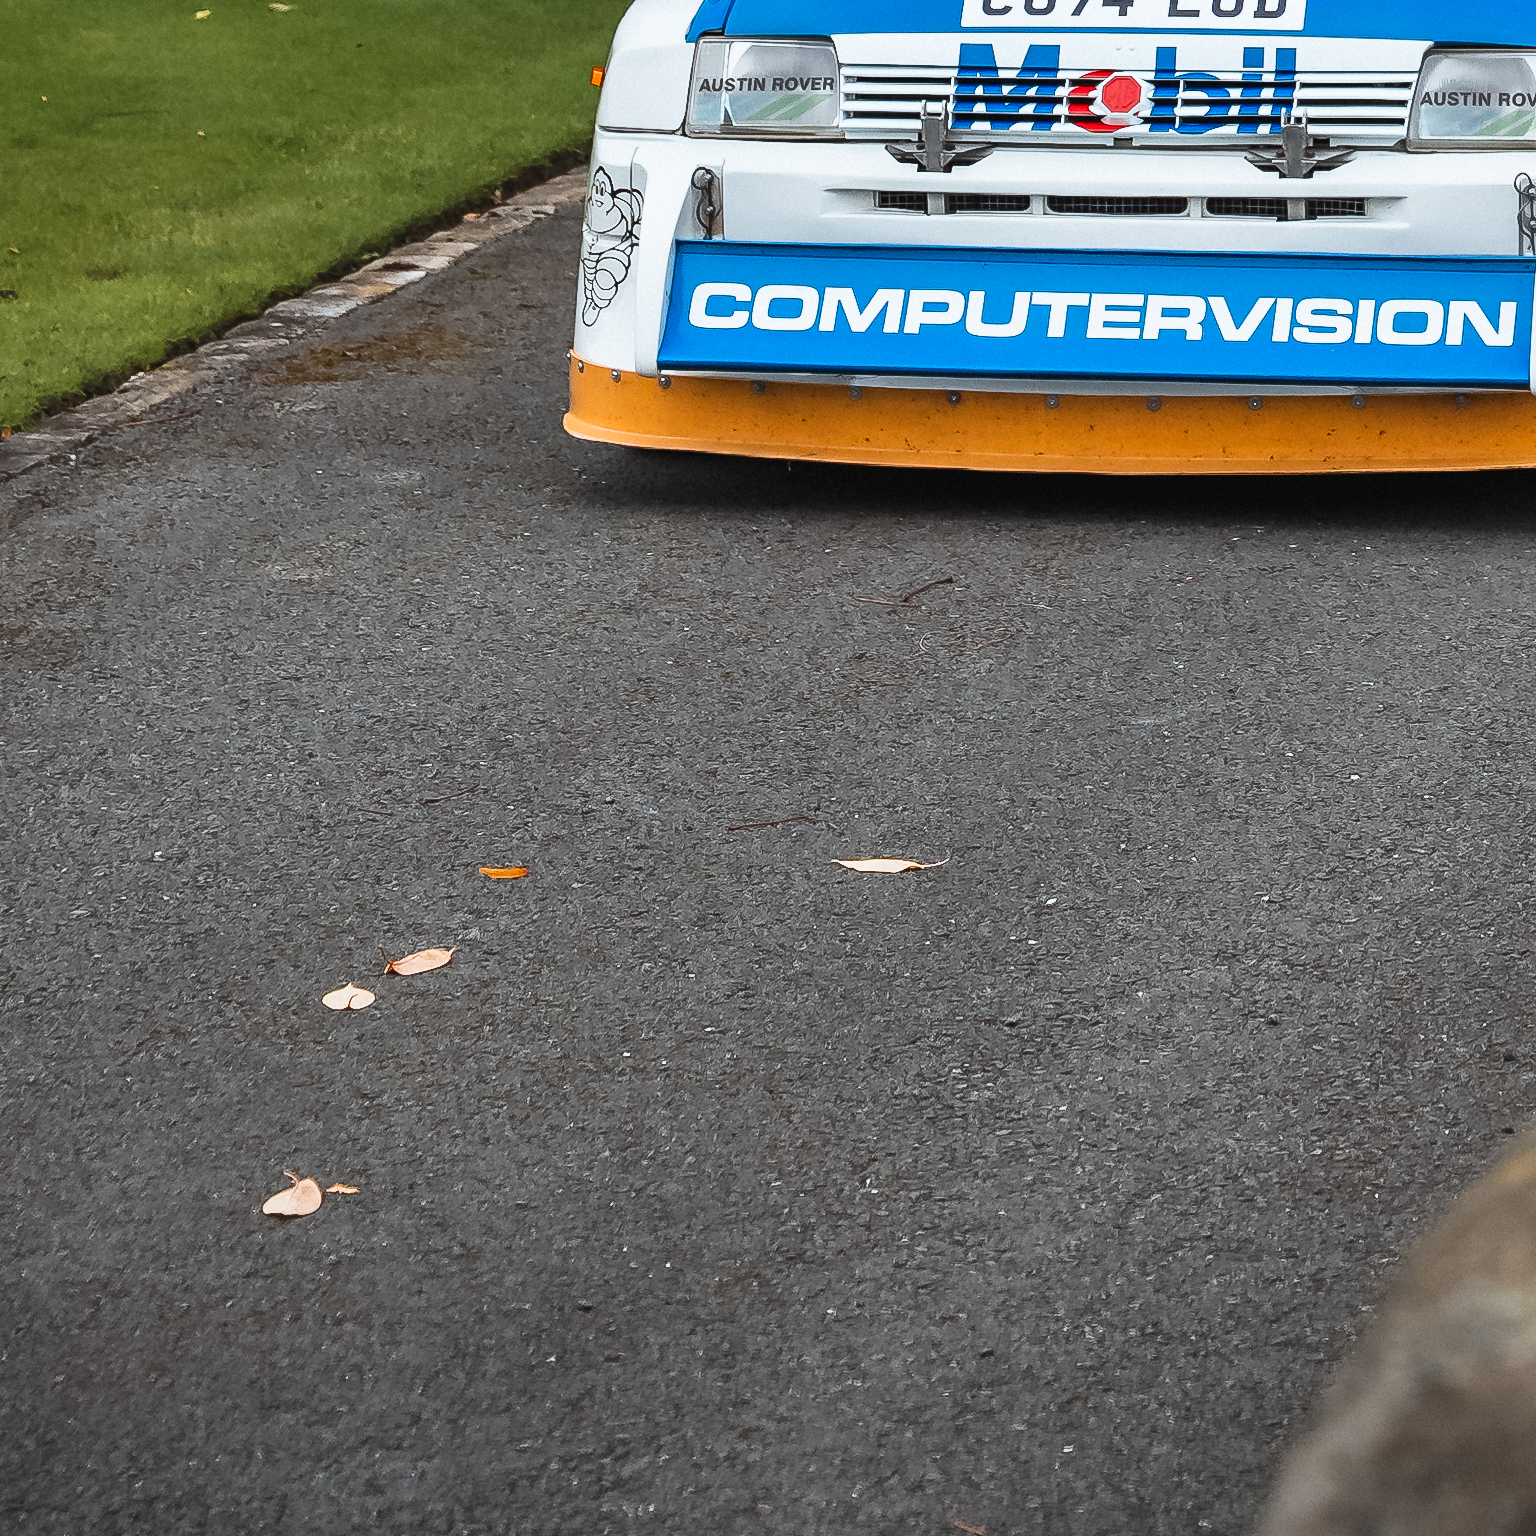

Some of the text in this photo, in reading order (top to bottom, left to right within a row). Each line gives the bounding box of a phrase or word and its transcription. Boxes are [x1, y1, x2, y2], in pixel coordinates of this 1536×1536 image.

[698, 76, 835, 93] AUSTIN ROVER
[1419, 91, 1492, 107] AUSTIN
[687, 281, 1518, 347] COMPUTERVISION
